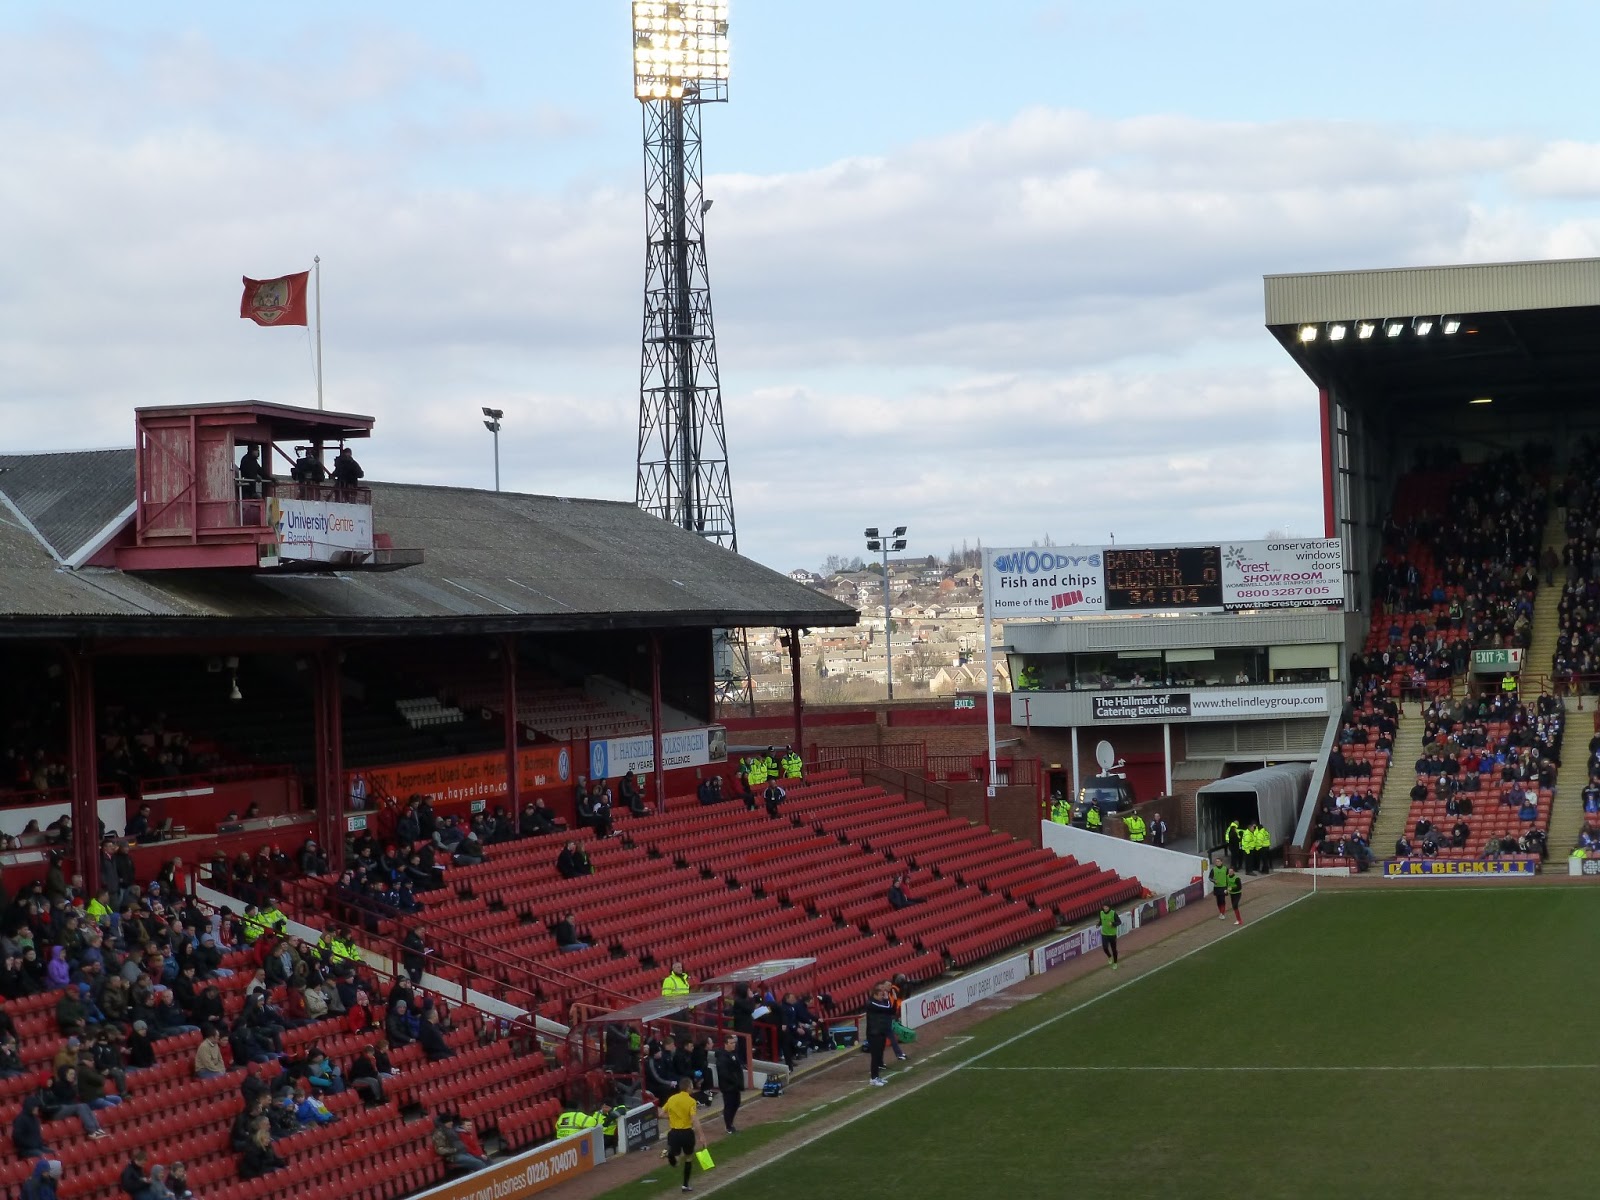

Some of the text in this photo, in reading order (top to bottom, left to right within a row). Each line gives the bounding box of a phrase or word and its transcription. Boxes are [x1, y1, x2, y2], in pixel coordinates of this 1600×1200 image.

[1267, 540, 1340, 552] conservatories
[1295, 550, 1341, 561] windows
[1002, 550, 1102, 574] WOODY'S
[1241, 562, 1270, 573] crest
[1311, 561, 1341, 571] doors
[1001, 574, 1097, 588] Fish and chips
[1243, 572, 1323, 583] SHOWROOM
[1237, 586, 1330, 598] 0800 3287 005
[995, 599, 1021, 607] Home
[1023, 598, 1033, 606] of
[1034, 598, 1049, 606] the
[1085, 596, 1103, 604] Cod
[1225, 599, 1342, 610] www.the-crestgroup.com
[1475, 650, 1518, 663] EXIT 1
[954, 699, 969, 707] EXIT
[1095, 695, 1170, 707] The Hallmark of
[1192, 695, 1324, 711] www.thelindleygroup.com
[1096, 705, 1187, 718] Catering Excellence
[620, 739, 654, 760] HAYSELDE
[662, 734, 704, 754] OLKSWAGEN
[493, 1173, 527, 1198] business
[526, 1160, 549, 1185] 01226
[550, 1148, 578, 1176] 704070
